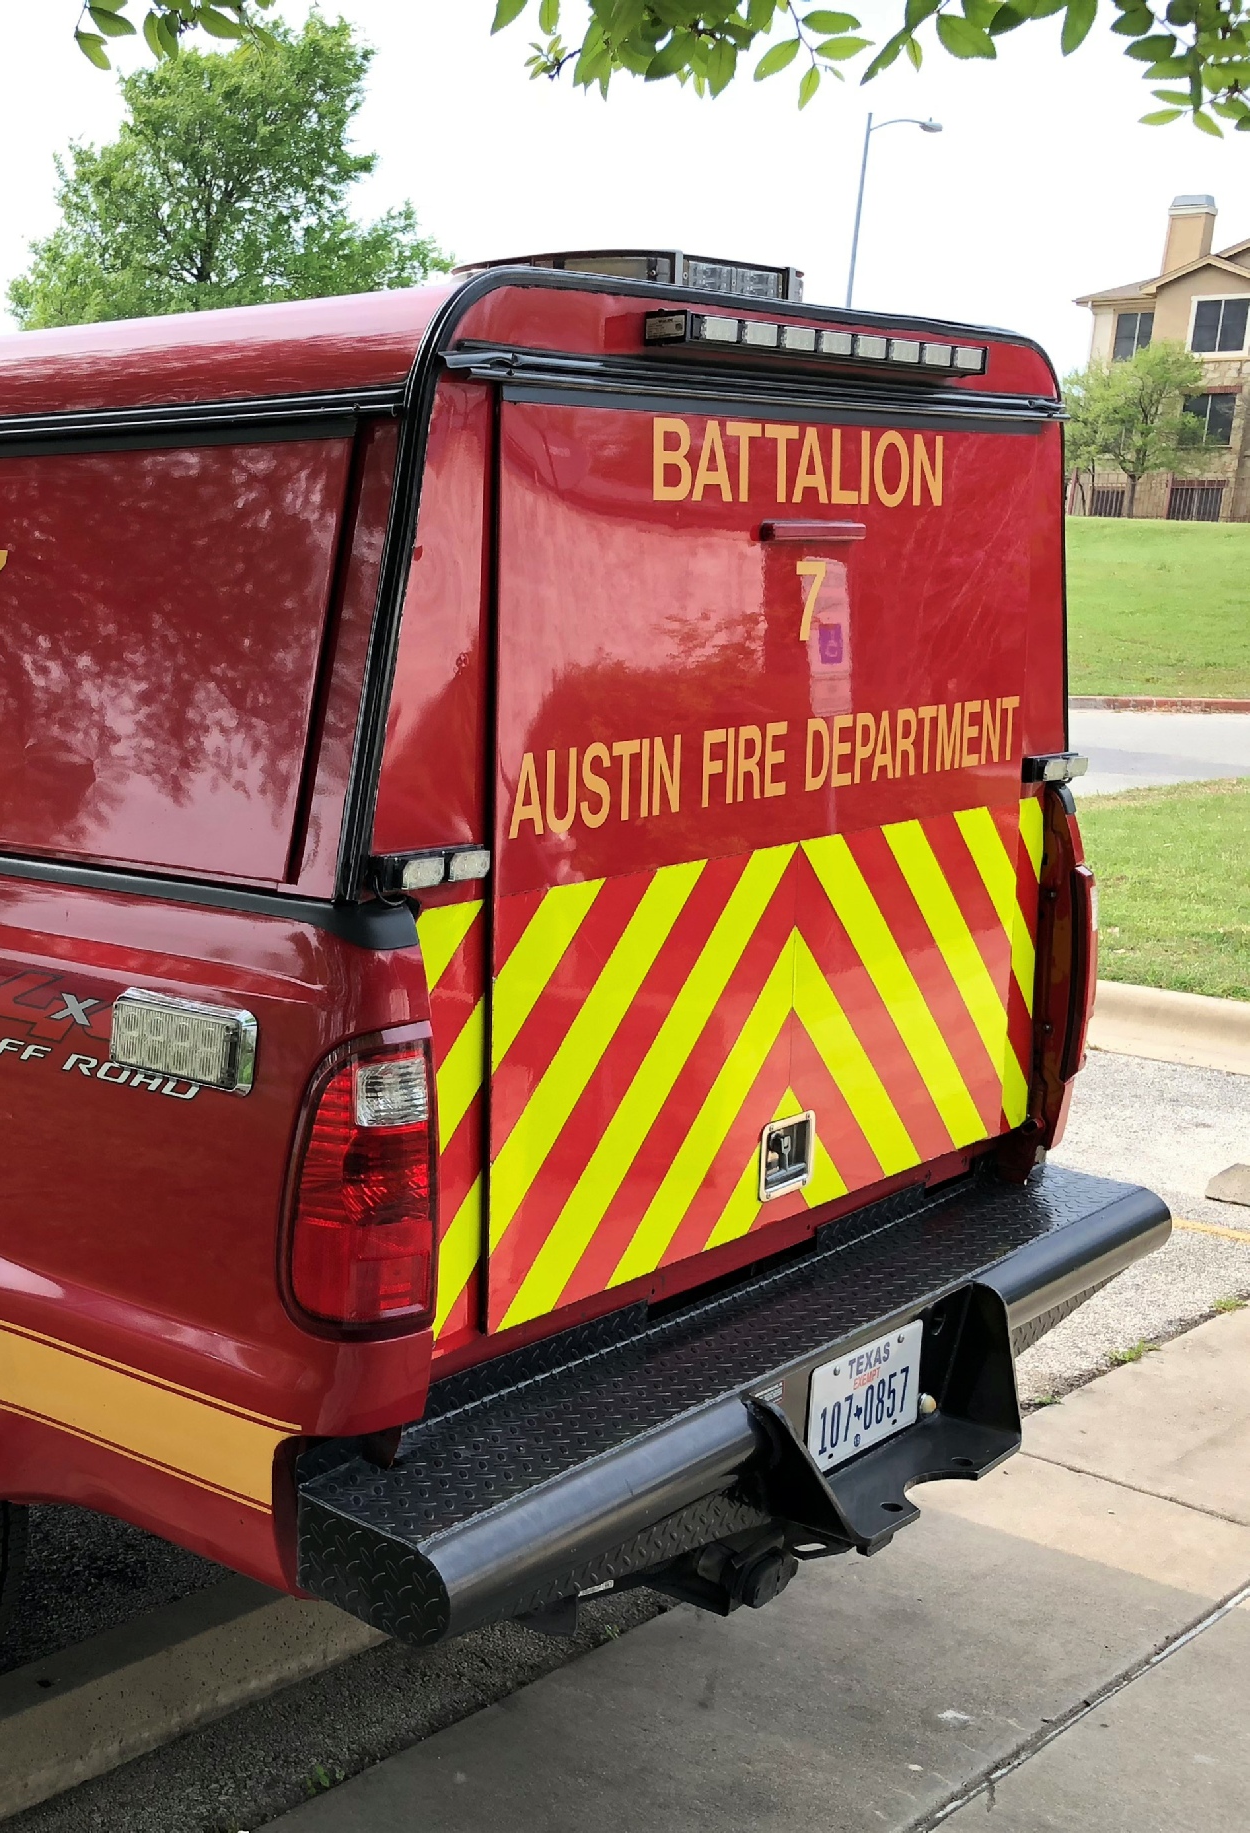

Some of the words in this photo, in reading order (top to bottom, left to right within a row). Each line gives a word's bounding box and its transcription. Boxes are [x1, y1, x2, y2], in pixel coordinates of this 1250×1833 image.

[652, 416, 944, 508] BATTALION
[794, 560, 827, 642] 7
[508, 734, 682, 840] AUSTIN
[701, 720, 788, 808] FIRE
[804, 695, 1021, 791] DEPARTMENT
[848, 1341, 891, 1379] TEXAS
[852, 1367, 881, 1391] EXEMPT
